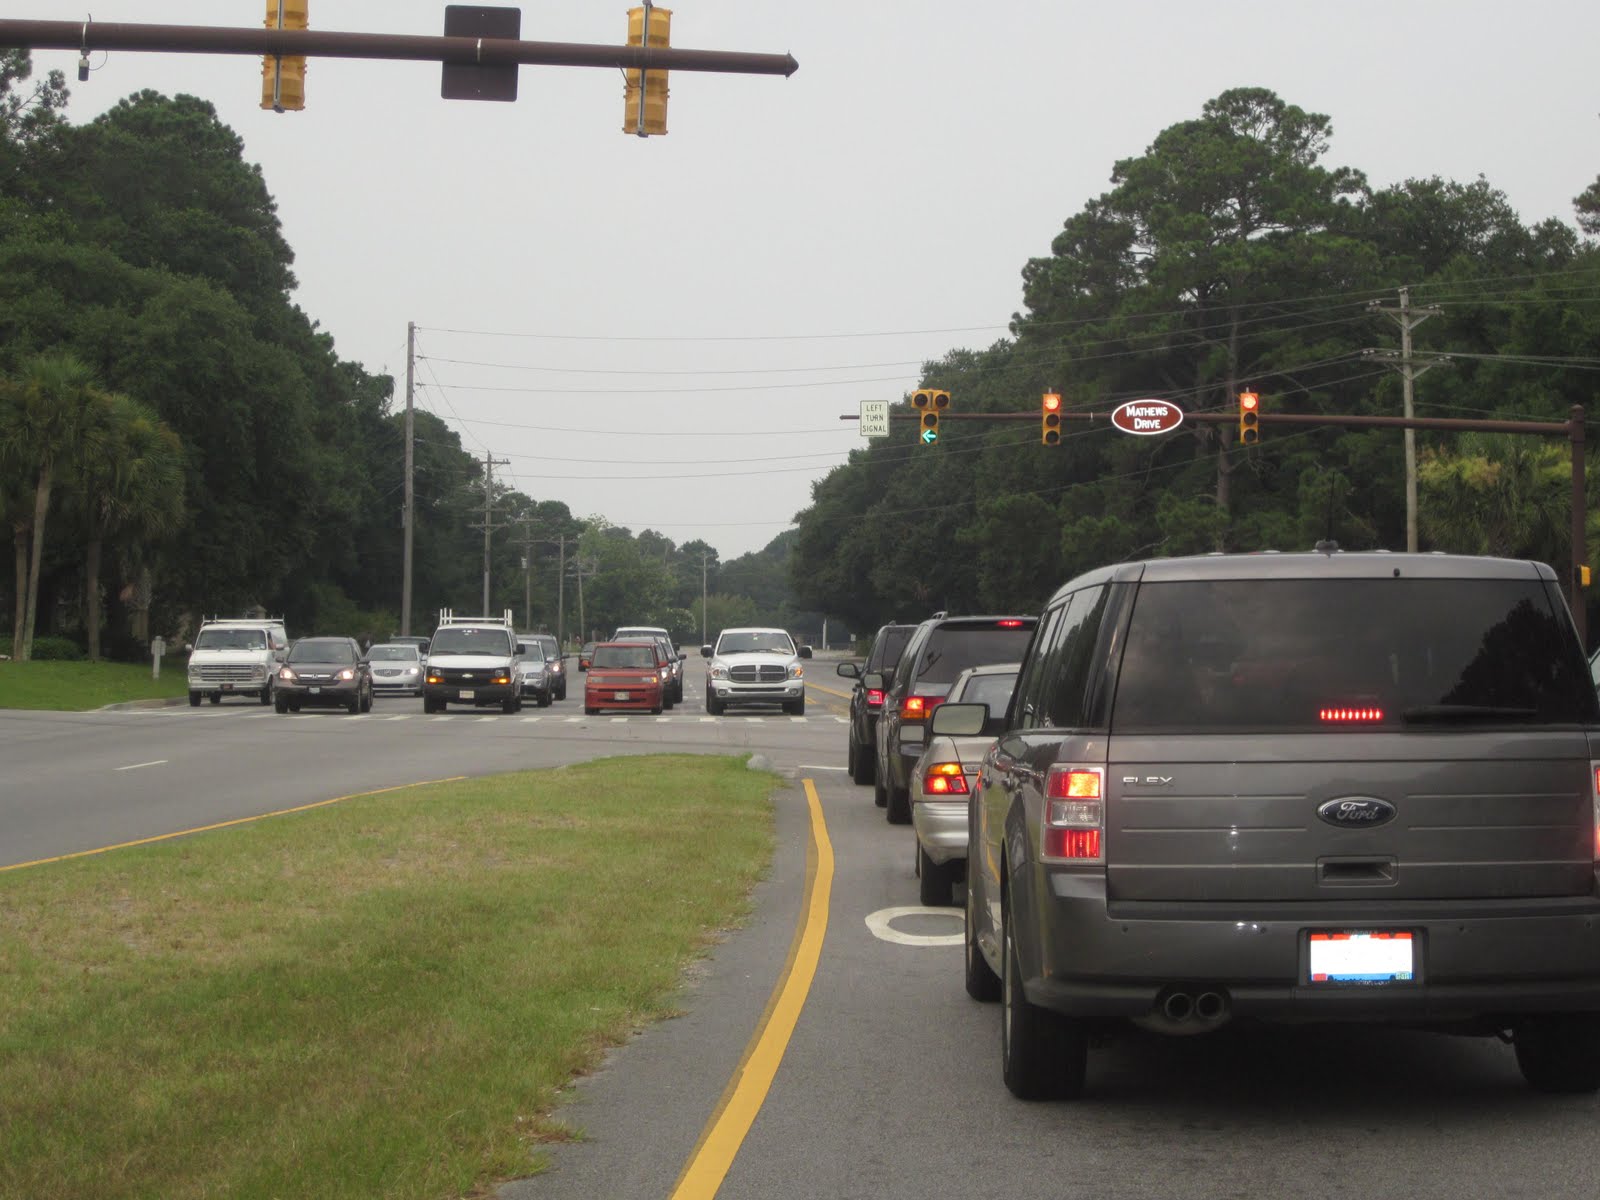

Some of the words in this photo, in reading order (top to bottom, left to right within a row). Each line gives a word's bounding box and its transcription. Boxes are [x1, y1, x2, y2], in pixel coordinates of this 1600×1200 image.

[866, 404, 882, 412] LEFT
[1126, 405, 1168, 416] MATHEWS
[866, 414, 884, 422] TURN
[1134, 418, 1161, 429] DRIVE
[862, 425, 887, 433] SIGNAL
[1122, 776, 1174, 786] FLEX
[1336, 801, 1379, 820] Ford
